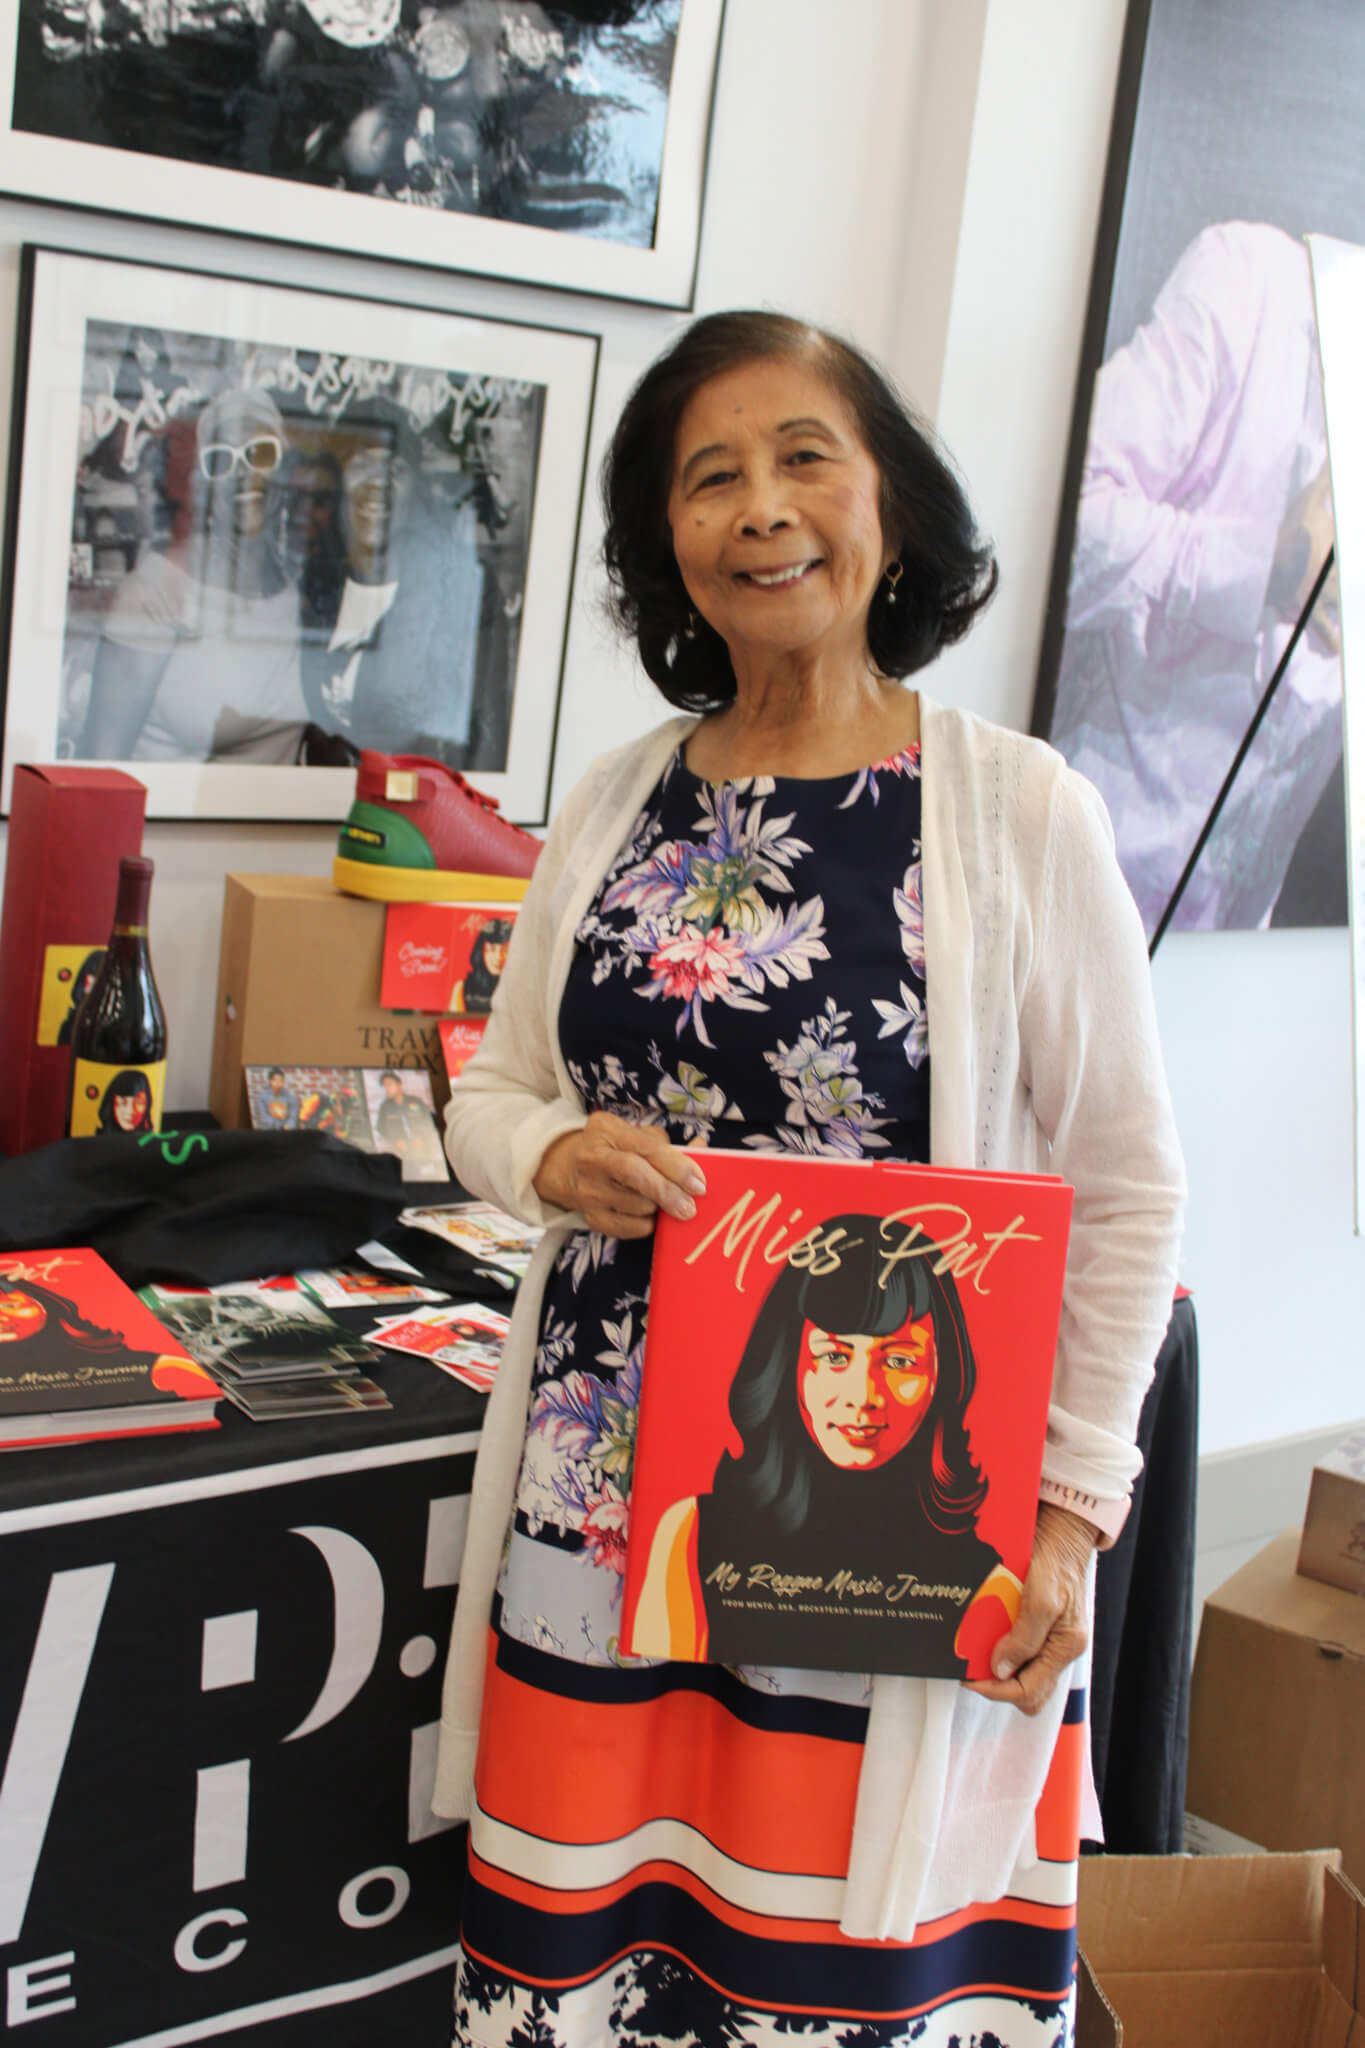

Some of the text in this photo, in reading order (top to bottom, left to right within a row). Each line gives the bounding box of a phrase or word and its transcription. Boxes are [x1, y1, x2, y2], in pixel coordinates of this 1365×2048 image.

[685, 1188, 1043, 1295] Miss Pat
[704, 1561, 972, 1607] My Reggae Music Journey
[722, 1598, 745, 1609] FROM
